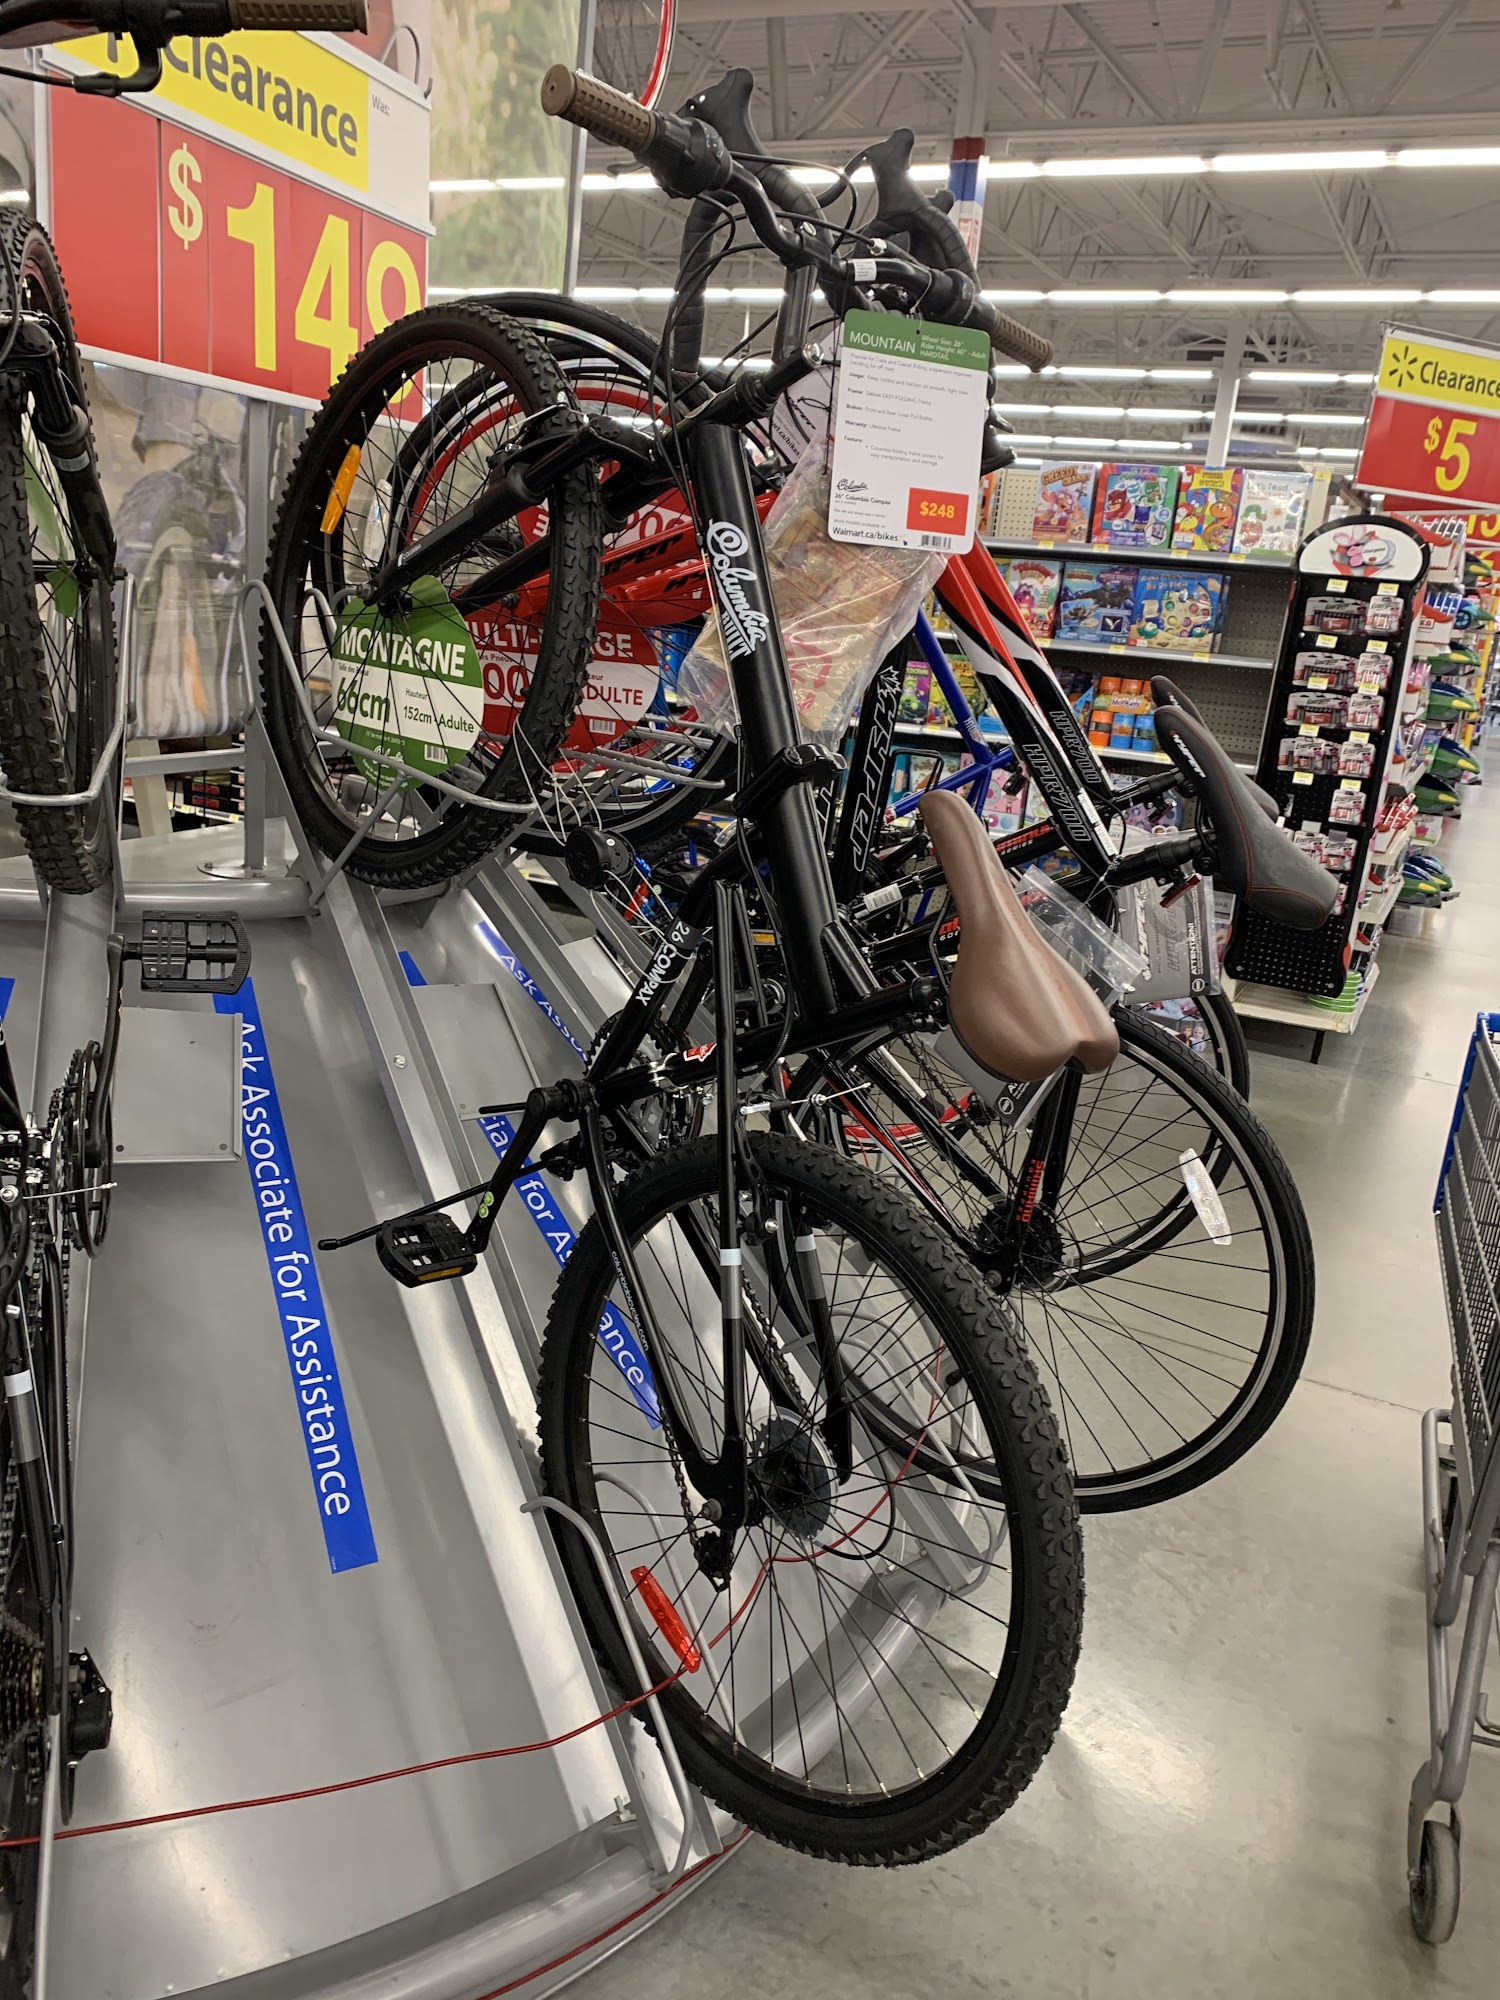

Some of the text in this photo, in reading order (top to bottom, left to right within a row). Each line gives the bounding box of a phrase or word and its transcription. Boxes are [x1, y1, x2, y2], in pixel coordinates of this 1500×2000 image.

[160, 33, 359, 157] Clearance
[371, 94, 391, 117] Was:
[850, 331, 916, 353] MOUNTAIN
[920, 350, 950, 361] HARDTAIL
[921, 334, 938, 345] Wheel
[940, 337, 953, 346] Size:
[921, 342, 935, 351] Rider
[936, 344, 956, 355] Height:
[971, 350, 987, 360] Adult
[1419, 361, 1500, 398] Clearance
[1423, 415, 1477, 492] $5
[845, 494, 870, 504] Columbia
[920, 501, 955, 519] $248
[832, 526, 899, 542] Walmart.ca/bikes
[705, 517, 768, 653] Columbia
[340, 624, 466, 678] MONTAGNE
[490, 653, 513, 663] Pneus
[337, 677, 391, 723] 66cm
[403, 705, 475, 735] 152cm Adulte
[1022, 743, 1092, 842] HPR700
[1324, 841, 1354, 850] Energizer
[635, 920, 691, 1007] 26 COMPAX
[1188, 922, 1198, 975] ATTENTION!
[500, 954, 538, 996] Ask
[241, 1083, 294, 1244] Associate
[519, 1178, 556, 1222] for
[1021, 1159, 1045, 1223] SHIMANO
[273, 1250, 311, 1303] for
[611, 1250, 650, 1352] columbiabicycles.com
[285, 1312, 351, 1516] Assistance
